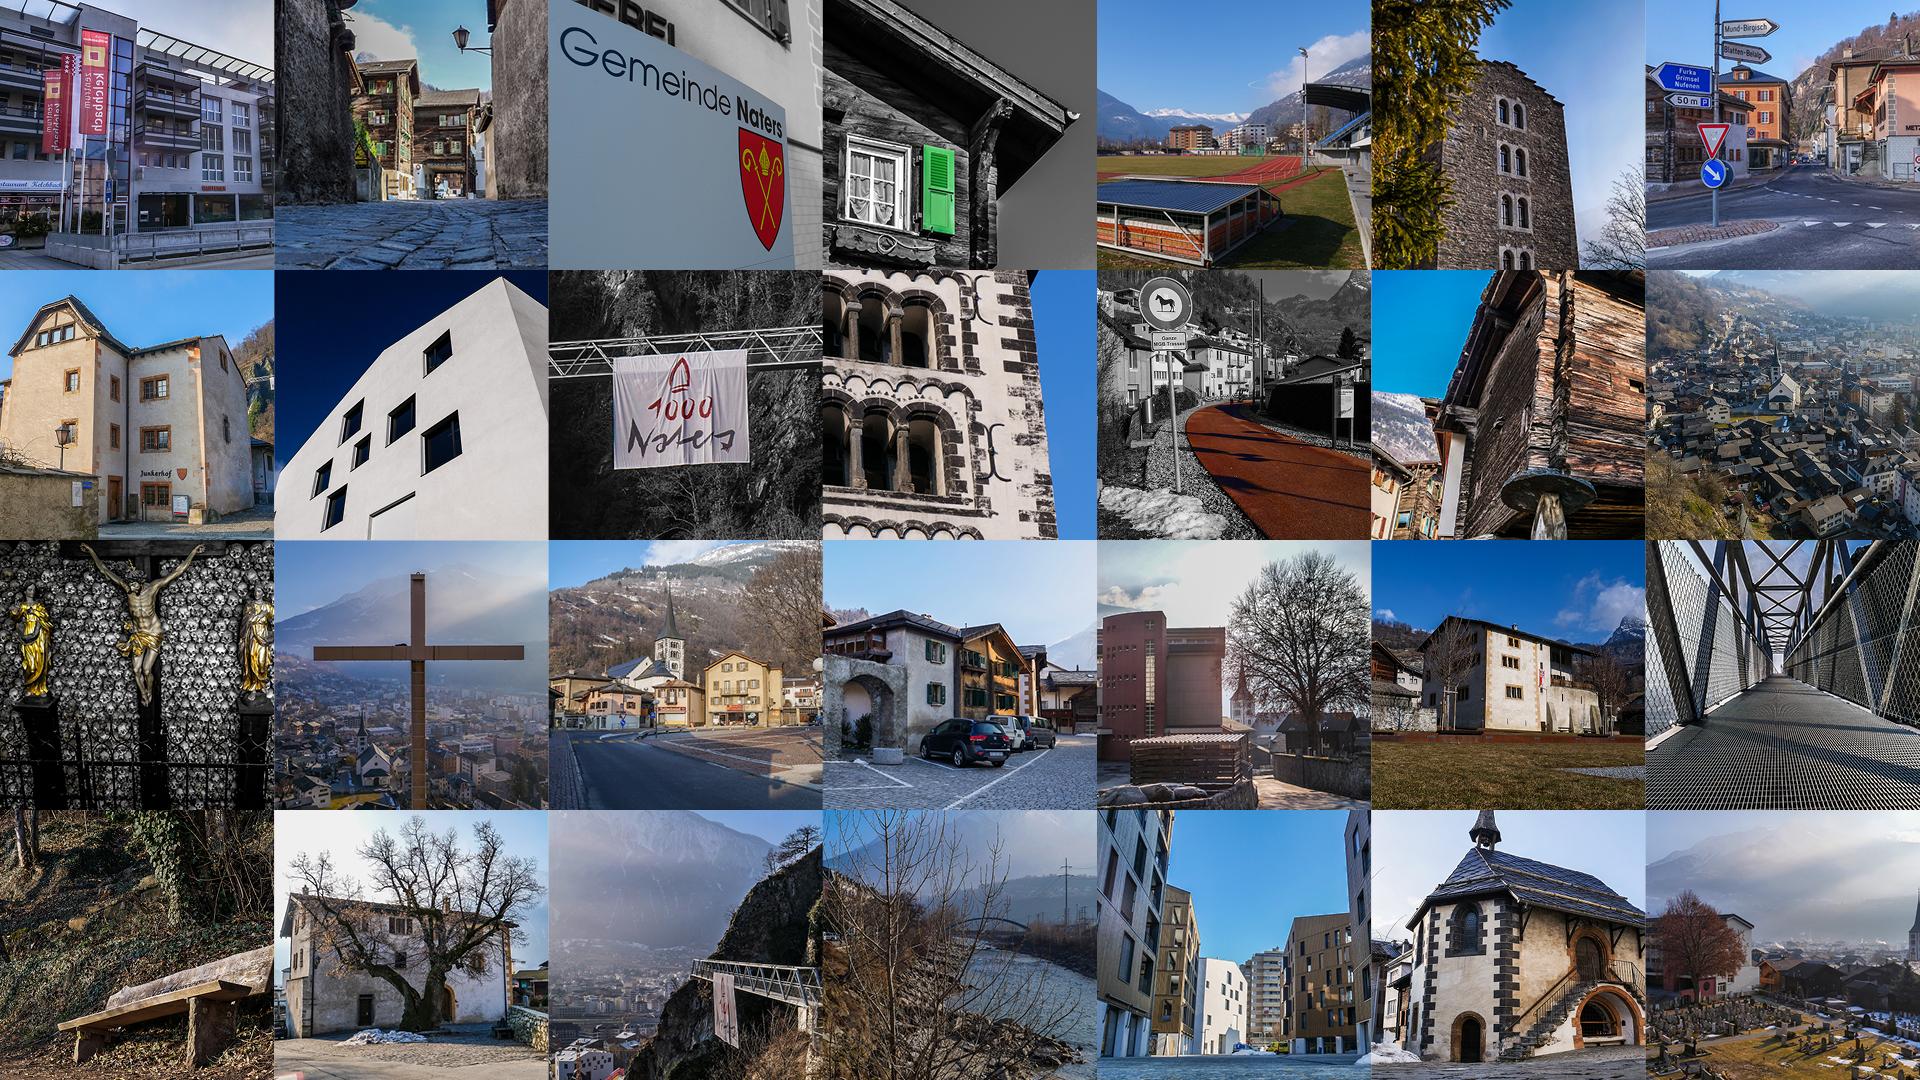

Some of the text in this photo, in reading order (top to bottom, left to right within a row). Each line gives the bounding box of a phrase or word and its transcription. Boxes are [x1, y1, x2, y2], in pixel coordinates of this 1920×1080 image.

[1724, 23, 1768, 33] Mund-Birgisch
[1724, 45, 1762, 60] Blatten-Belalp
[1679, 67, 1697, 76] Furka
[560, 26, 783, 139] Gemeinde Naters
[1675, 74, 1700, 83] Grimsel
[1674, 81, 1700, 89] Nufenen
[1677, 96, 1689, 105] 50
[647, 396, 712, 420] 1000
[628, 418, 735, 458] Naters
[140, 470, 172, 478] Junkerhof
